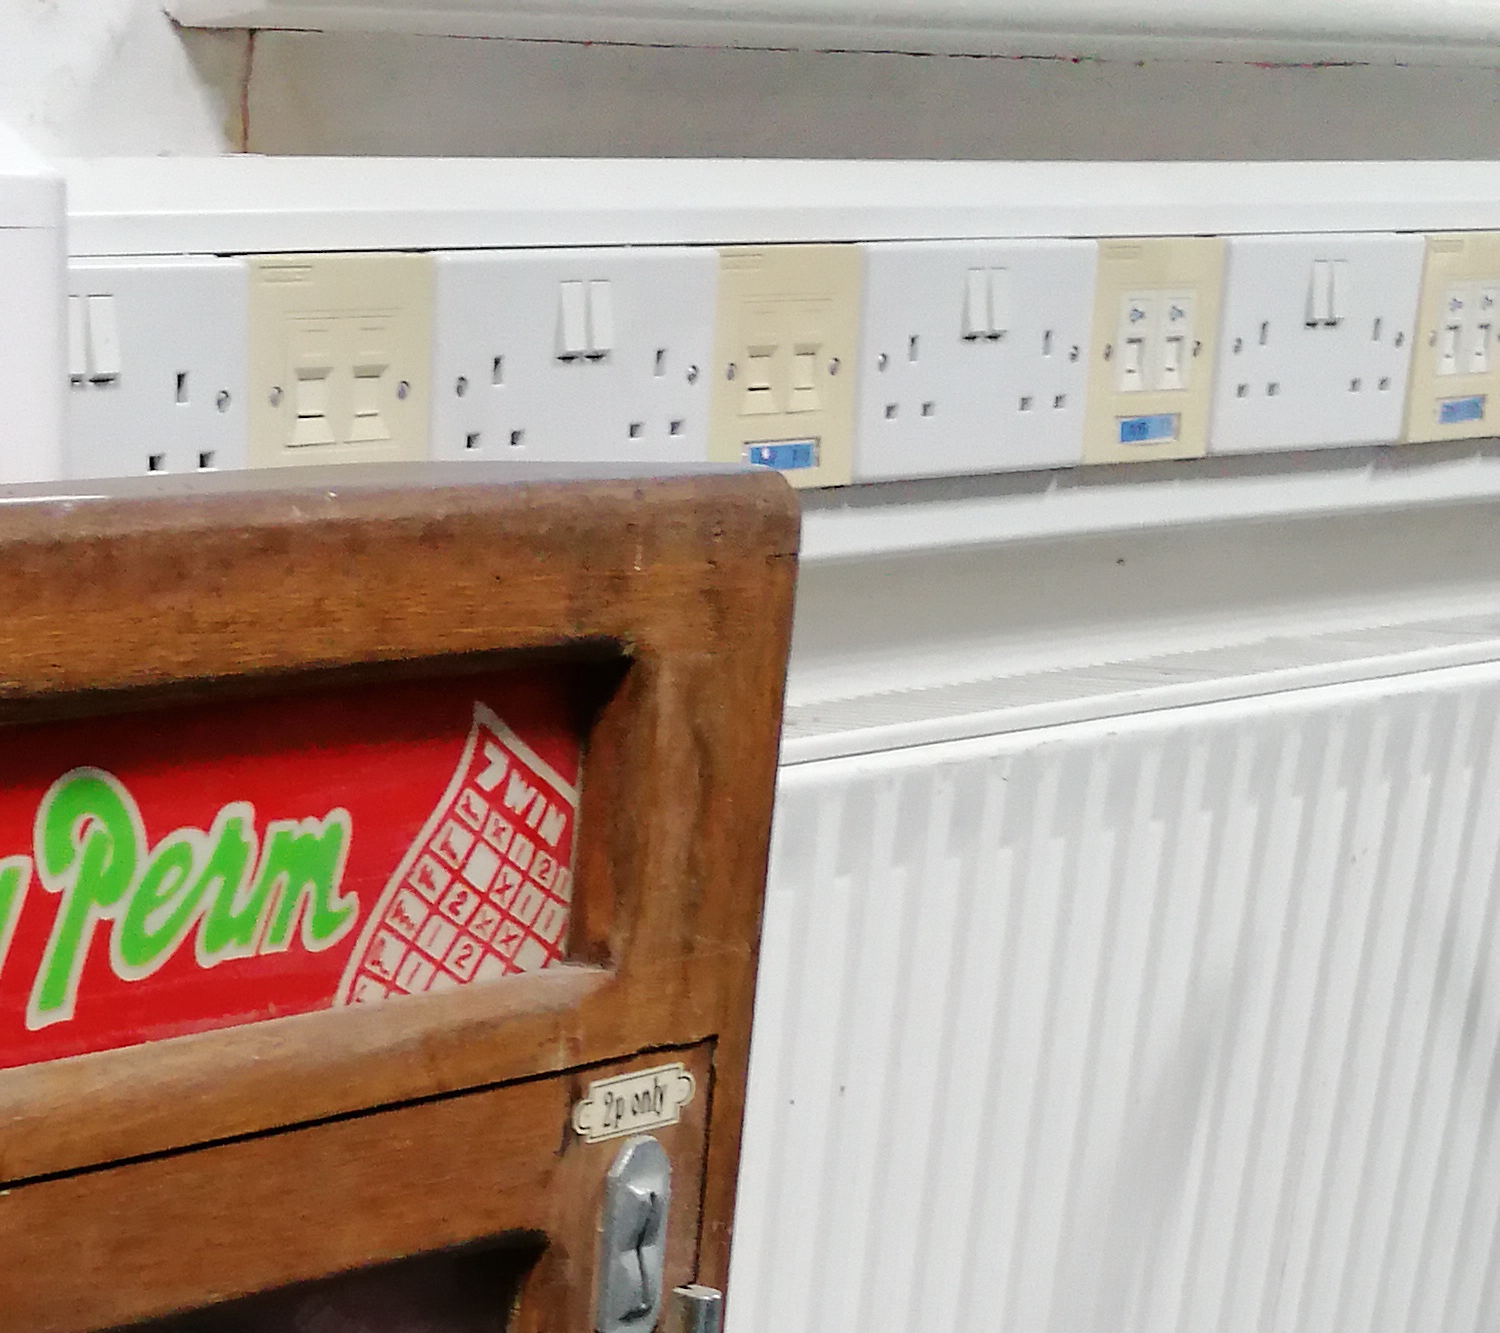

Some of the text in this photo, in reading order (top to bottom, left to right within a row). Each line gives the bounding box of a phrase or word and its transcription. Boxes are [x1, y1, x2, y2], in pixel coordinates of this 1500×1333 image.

[27, 767, 358, 1031] Perm
[604, 1076, 667, 1129] 2p only
